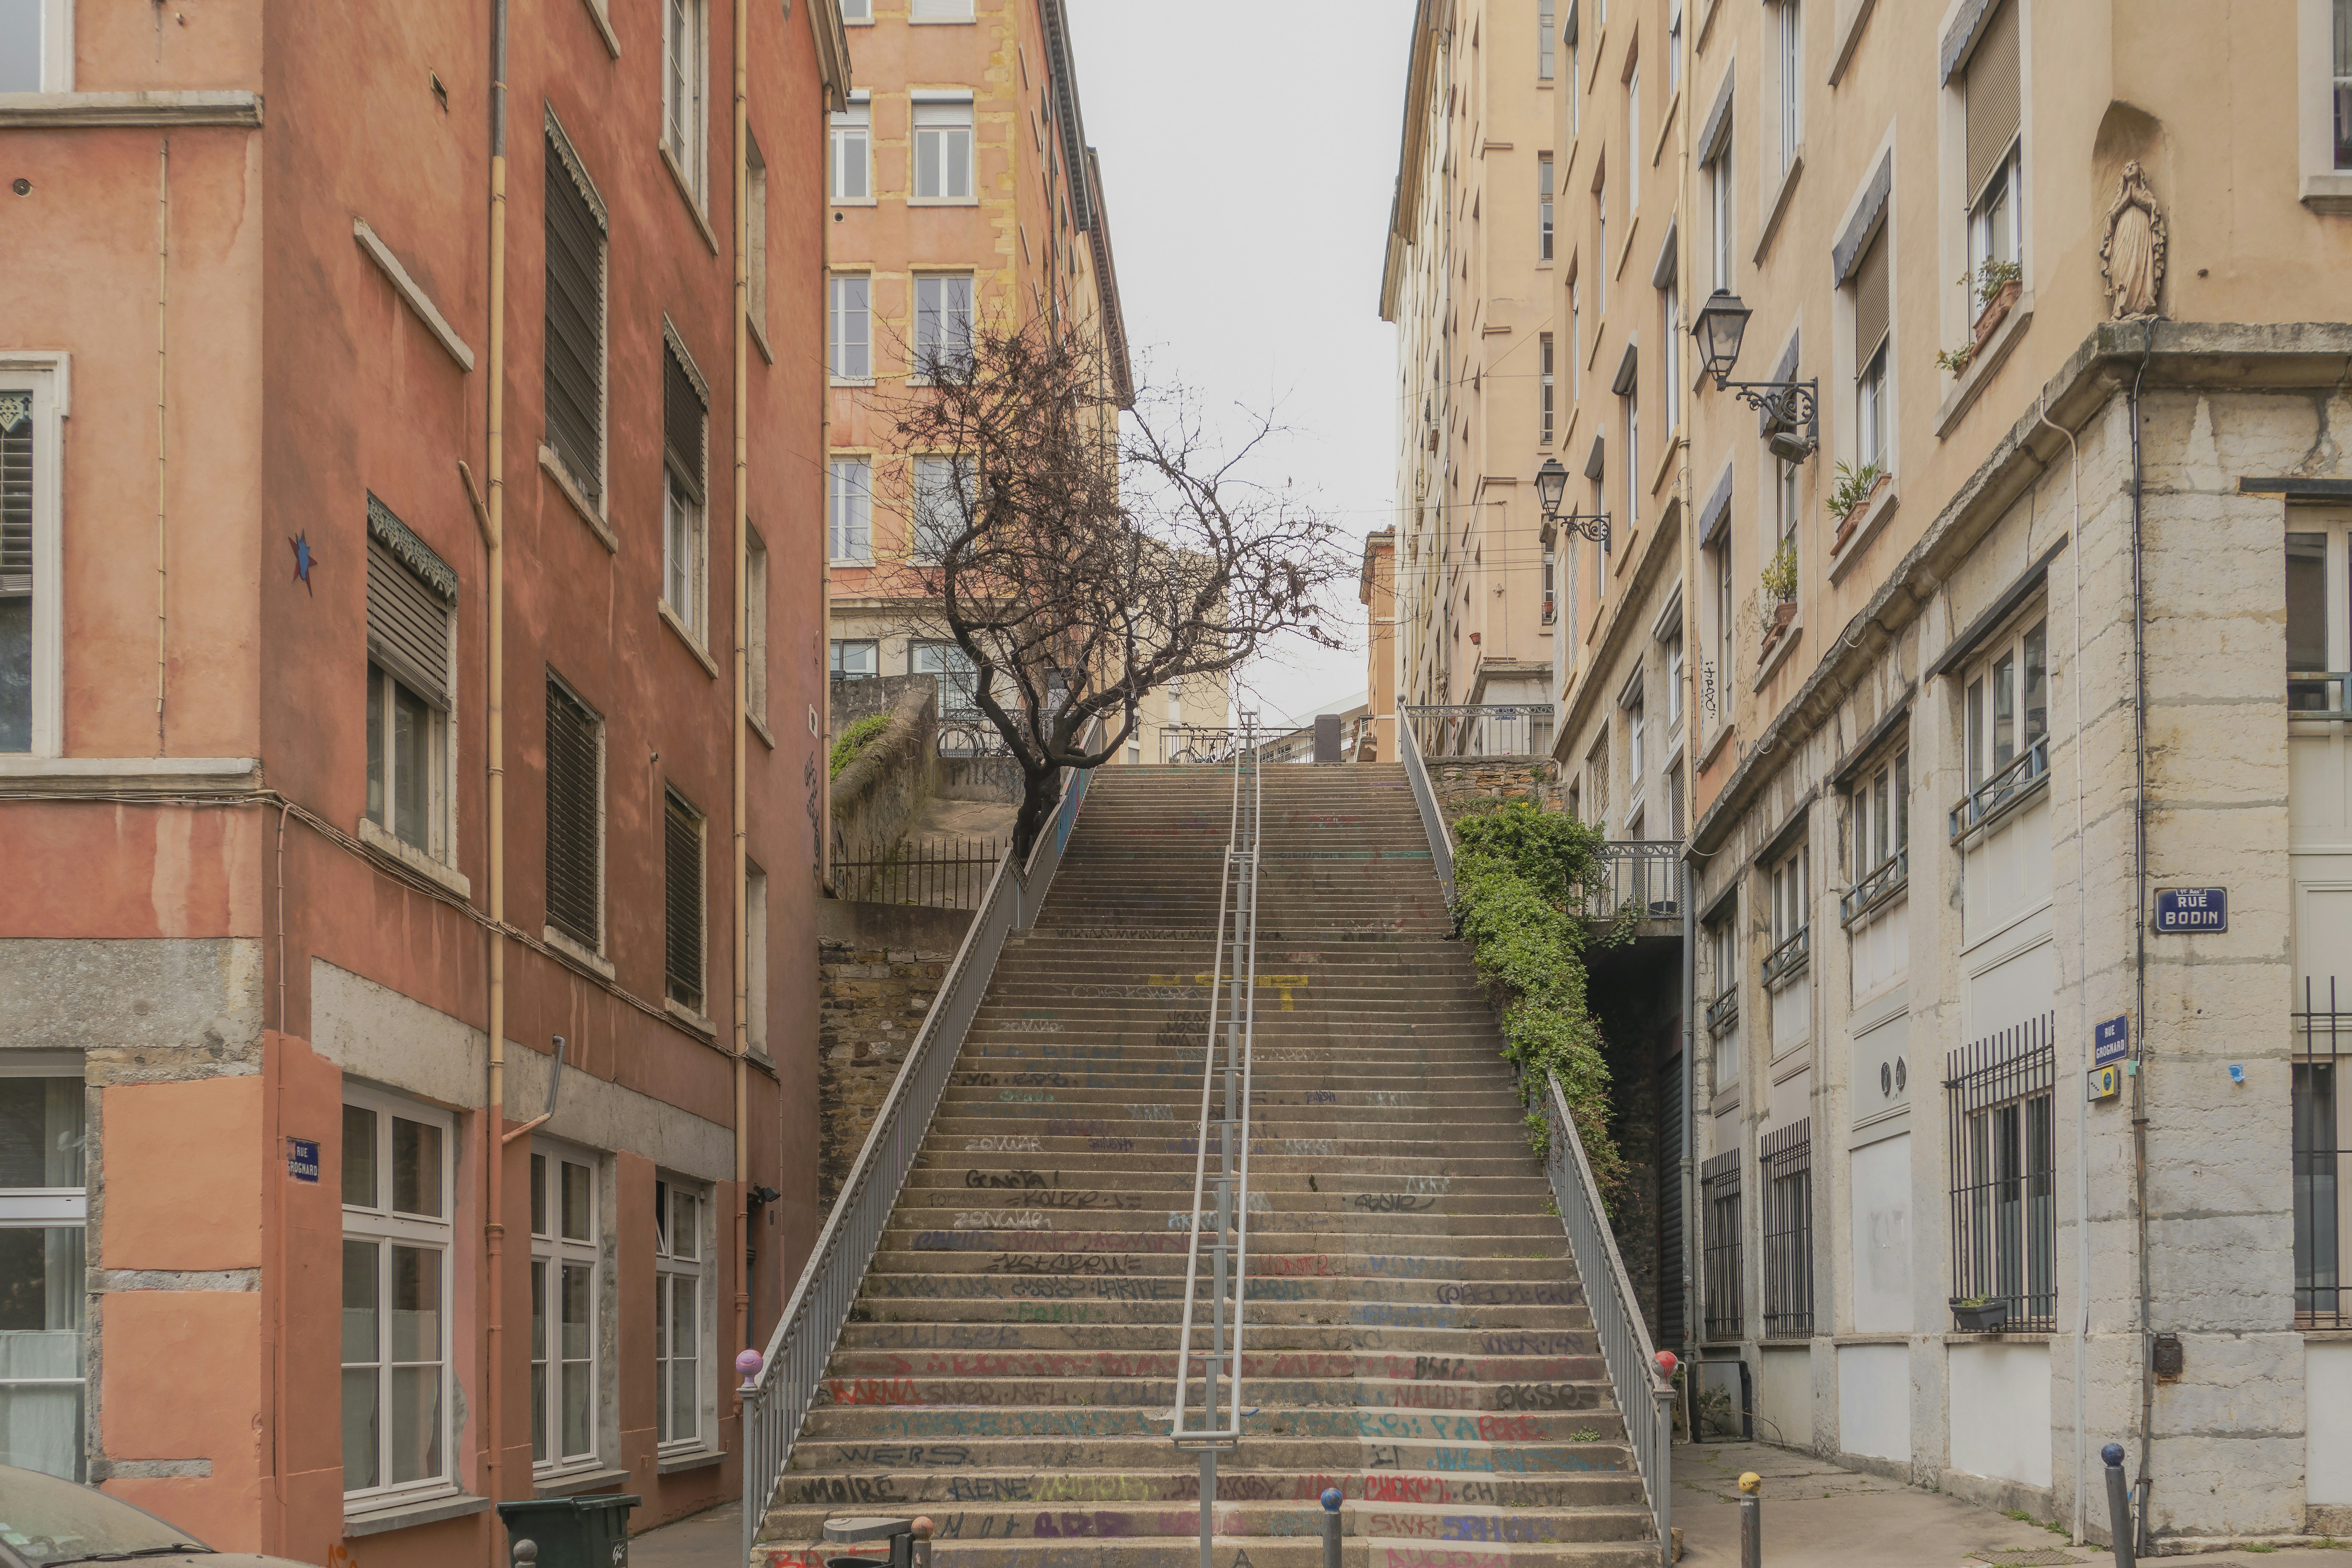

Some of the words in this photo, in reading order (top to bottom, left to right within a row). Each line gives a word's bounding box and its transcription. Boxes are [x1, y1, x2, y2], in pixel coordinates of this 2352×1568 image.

[2178, 897, 2207, 907] RUE
[2166, 911, 2218, 925] BODIN
[2104, 1024, 2115, 1038] RUE
[2096, 1039, 2125, 1059] GROGNARD
[297, 1146, 308, 1158] RUE
[829, 1378, 925, 1405] KARMA
[1442, 1515, 1556, 1542] SPHINX
